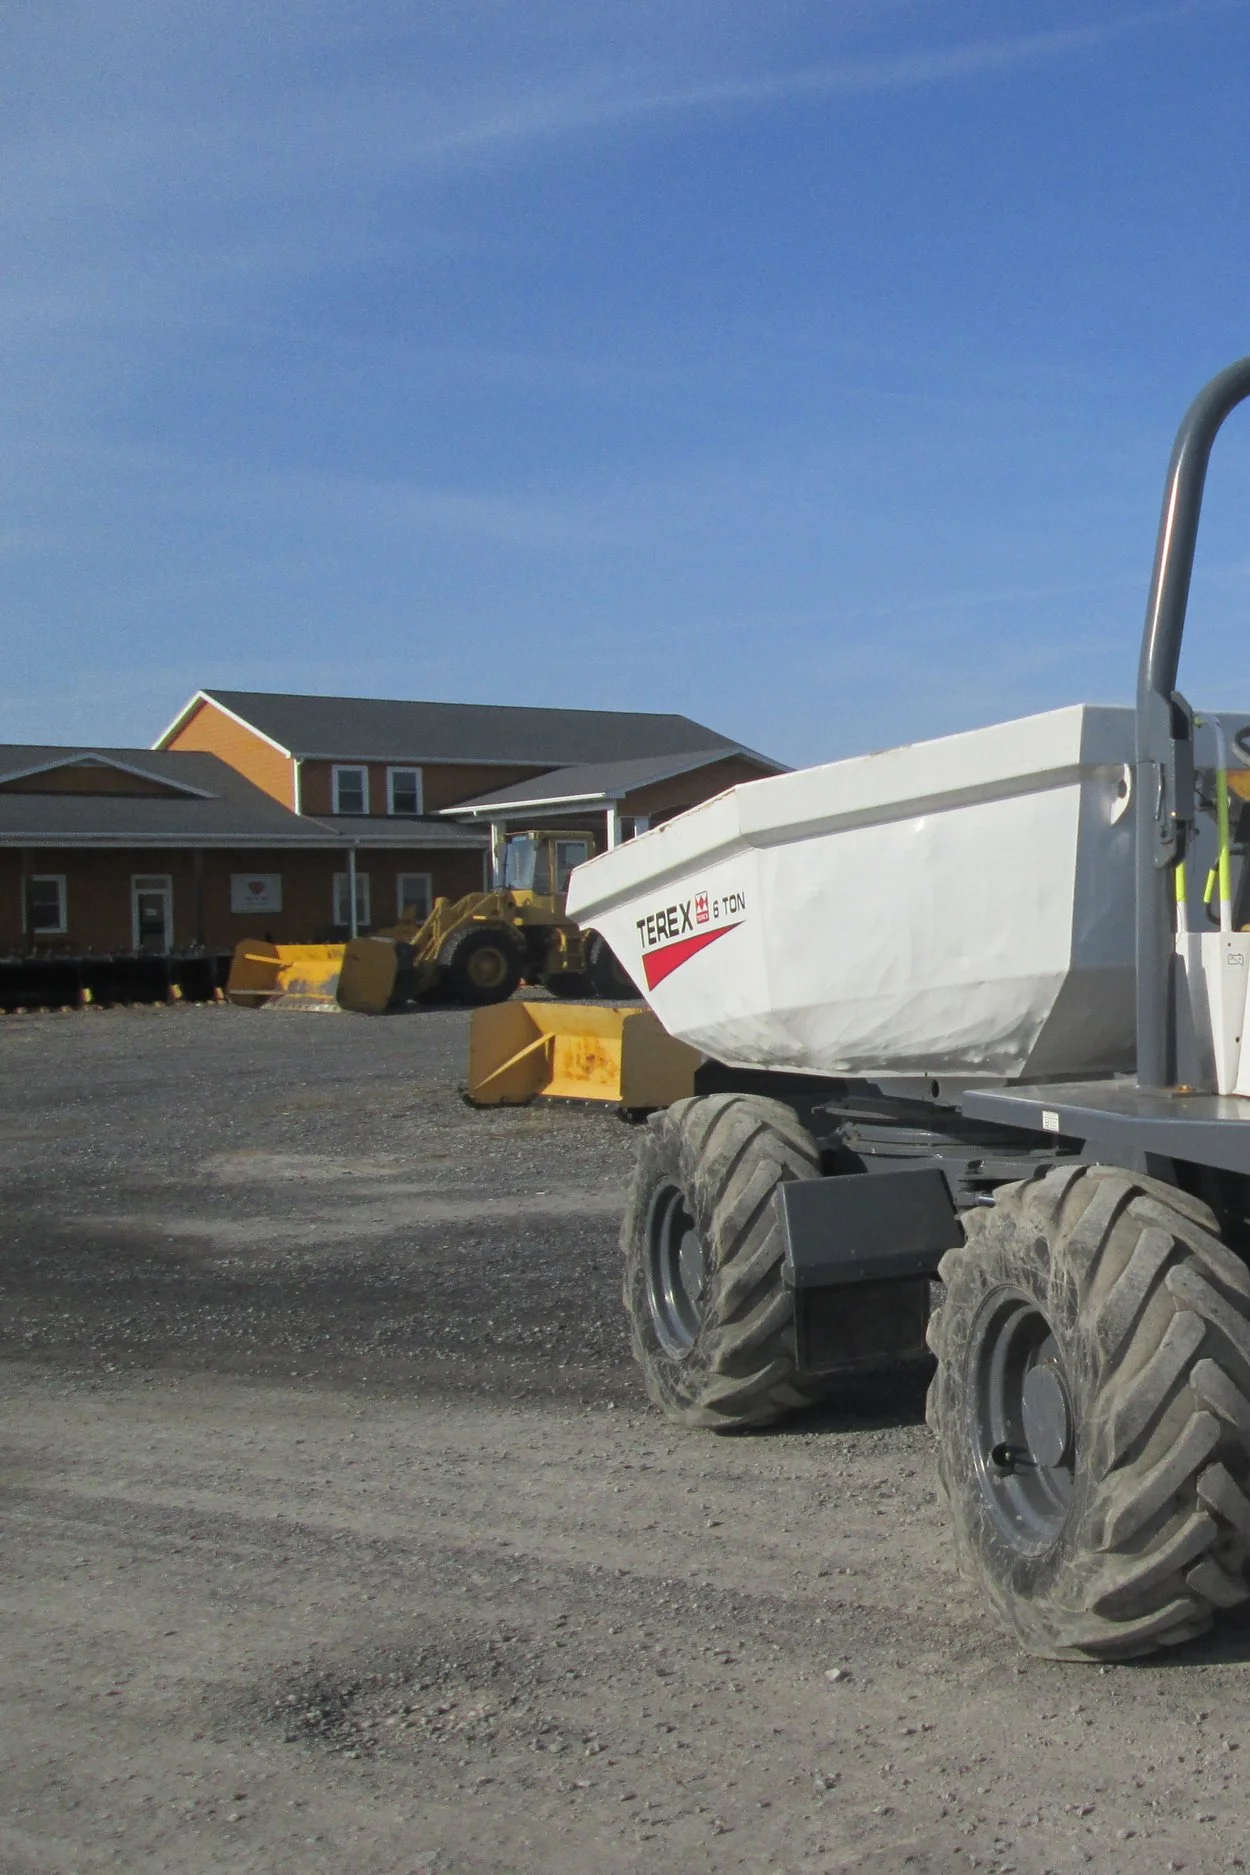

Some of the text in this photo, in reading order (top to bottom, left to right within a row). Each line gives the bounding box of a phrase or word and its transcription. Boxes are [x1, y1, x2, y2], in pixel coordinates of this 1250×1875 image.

[636, 891, 746, 948] TEREX 6 TON
